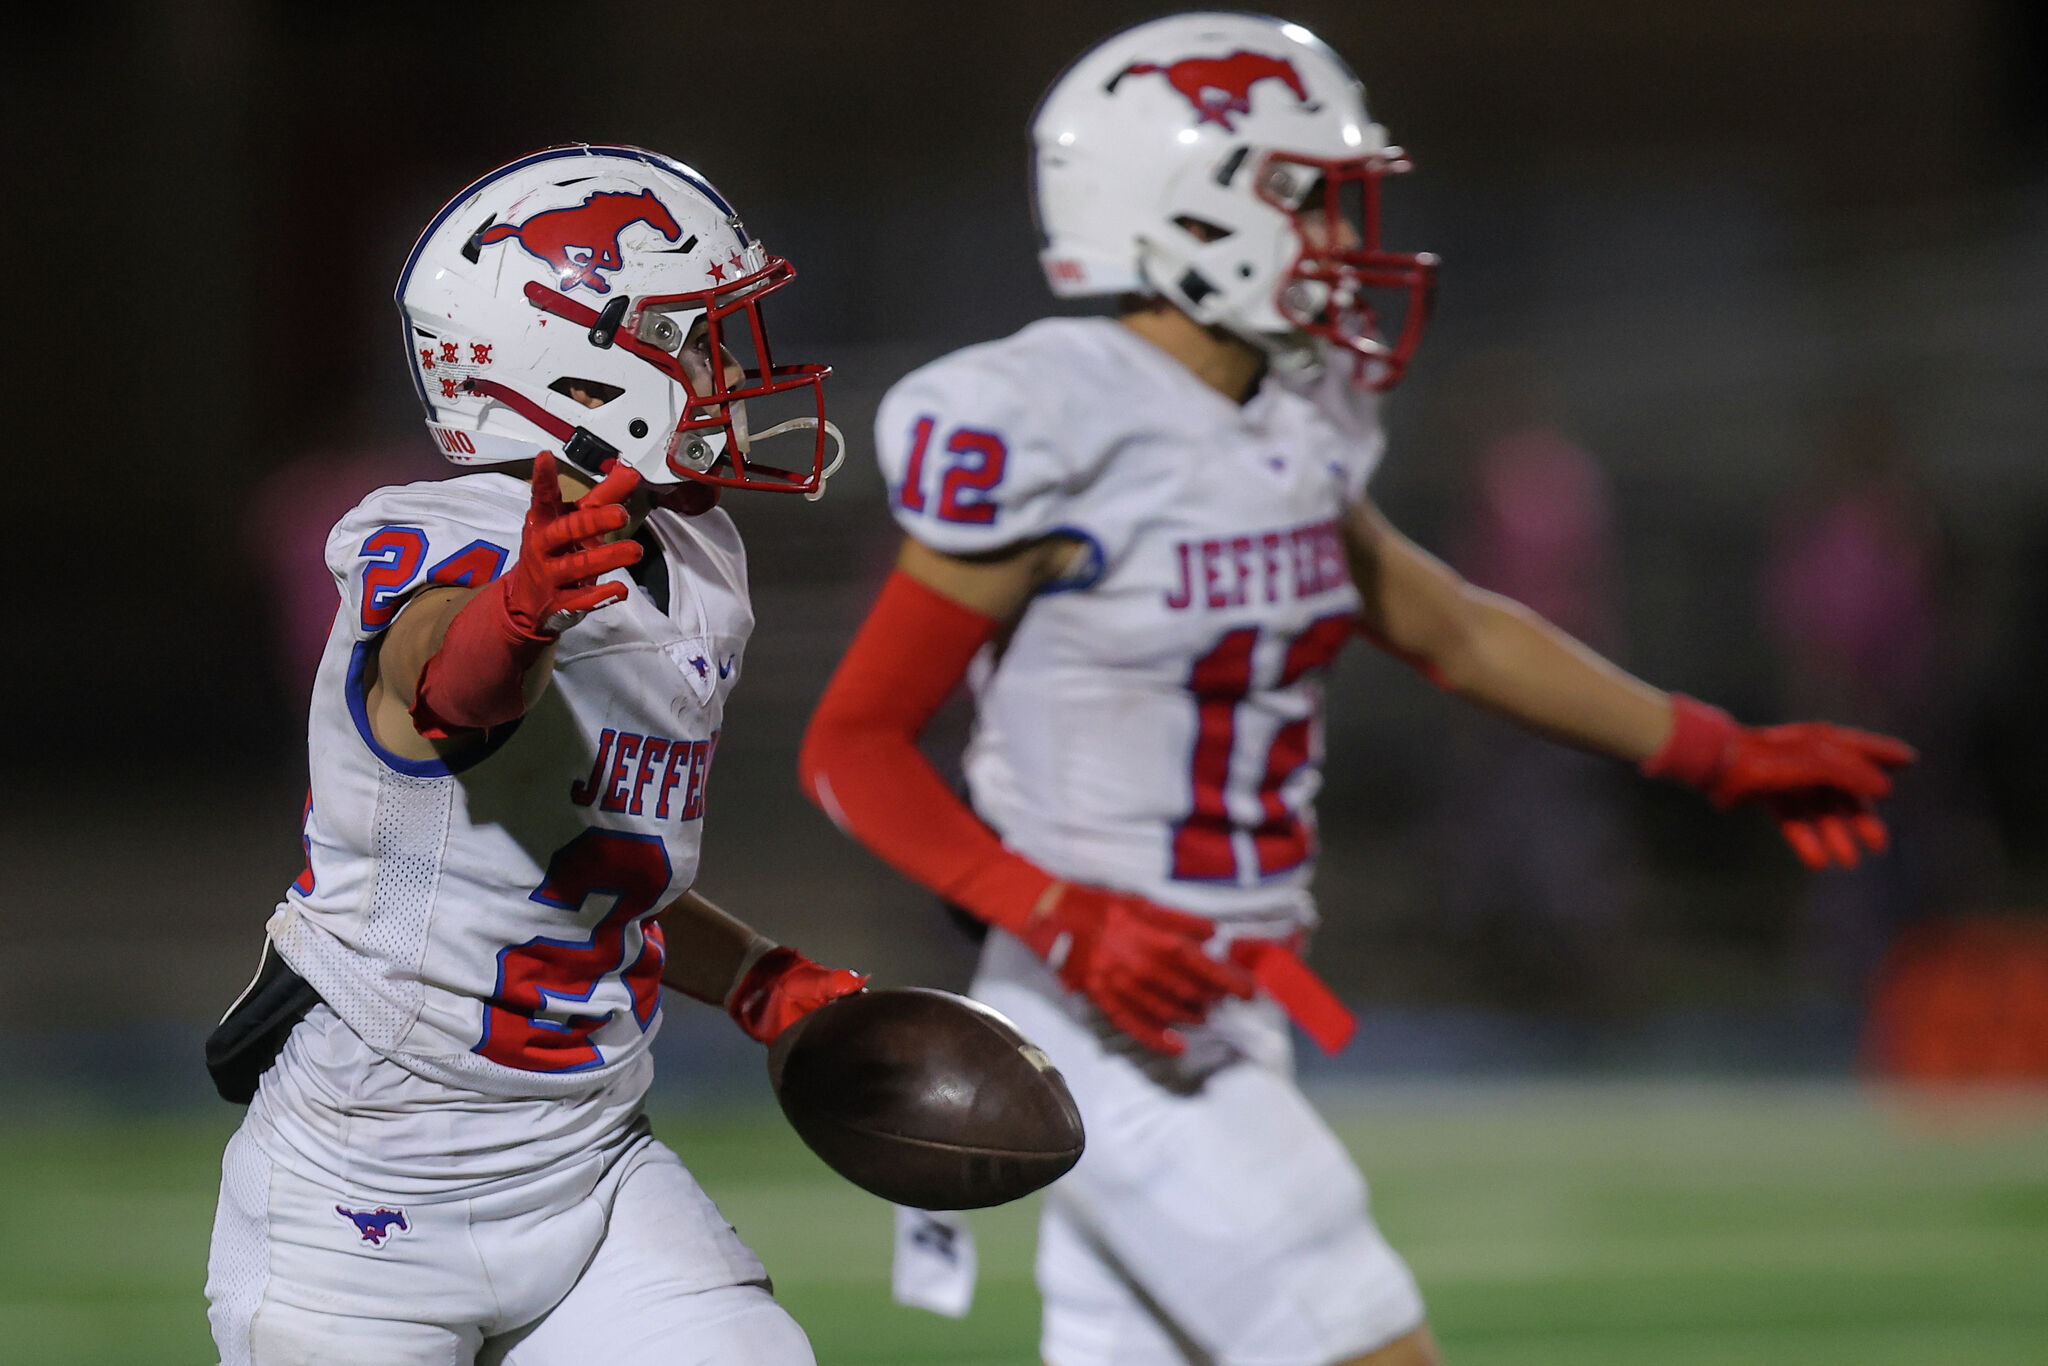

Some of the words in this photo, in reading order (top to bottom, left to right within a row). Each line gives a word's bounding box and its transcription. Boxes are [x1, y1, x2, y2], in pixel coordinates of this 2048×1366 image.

[898, 416, 1007, 526] 12
[358, 525, 510, 632] 24
[569, 728, 705, 822] JEFFE
